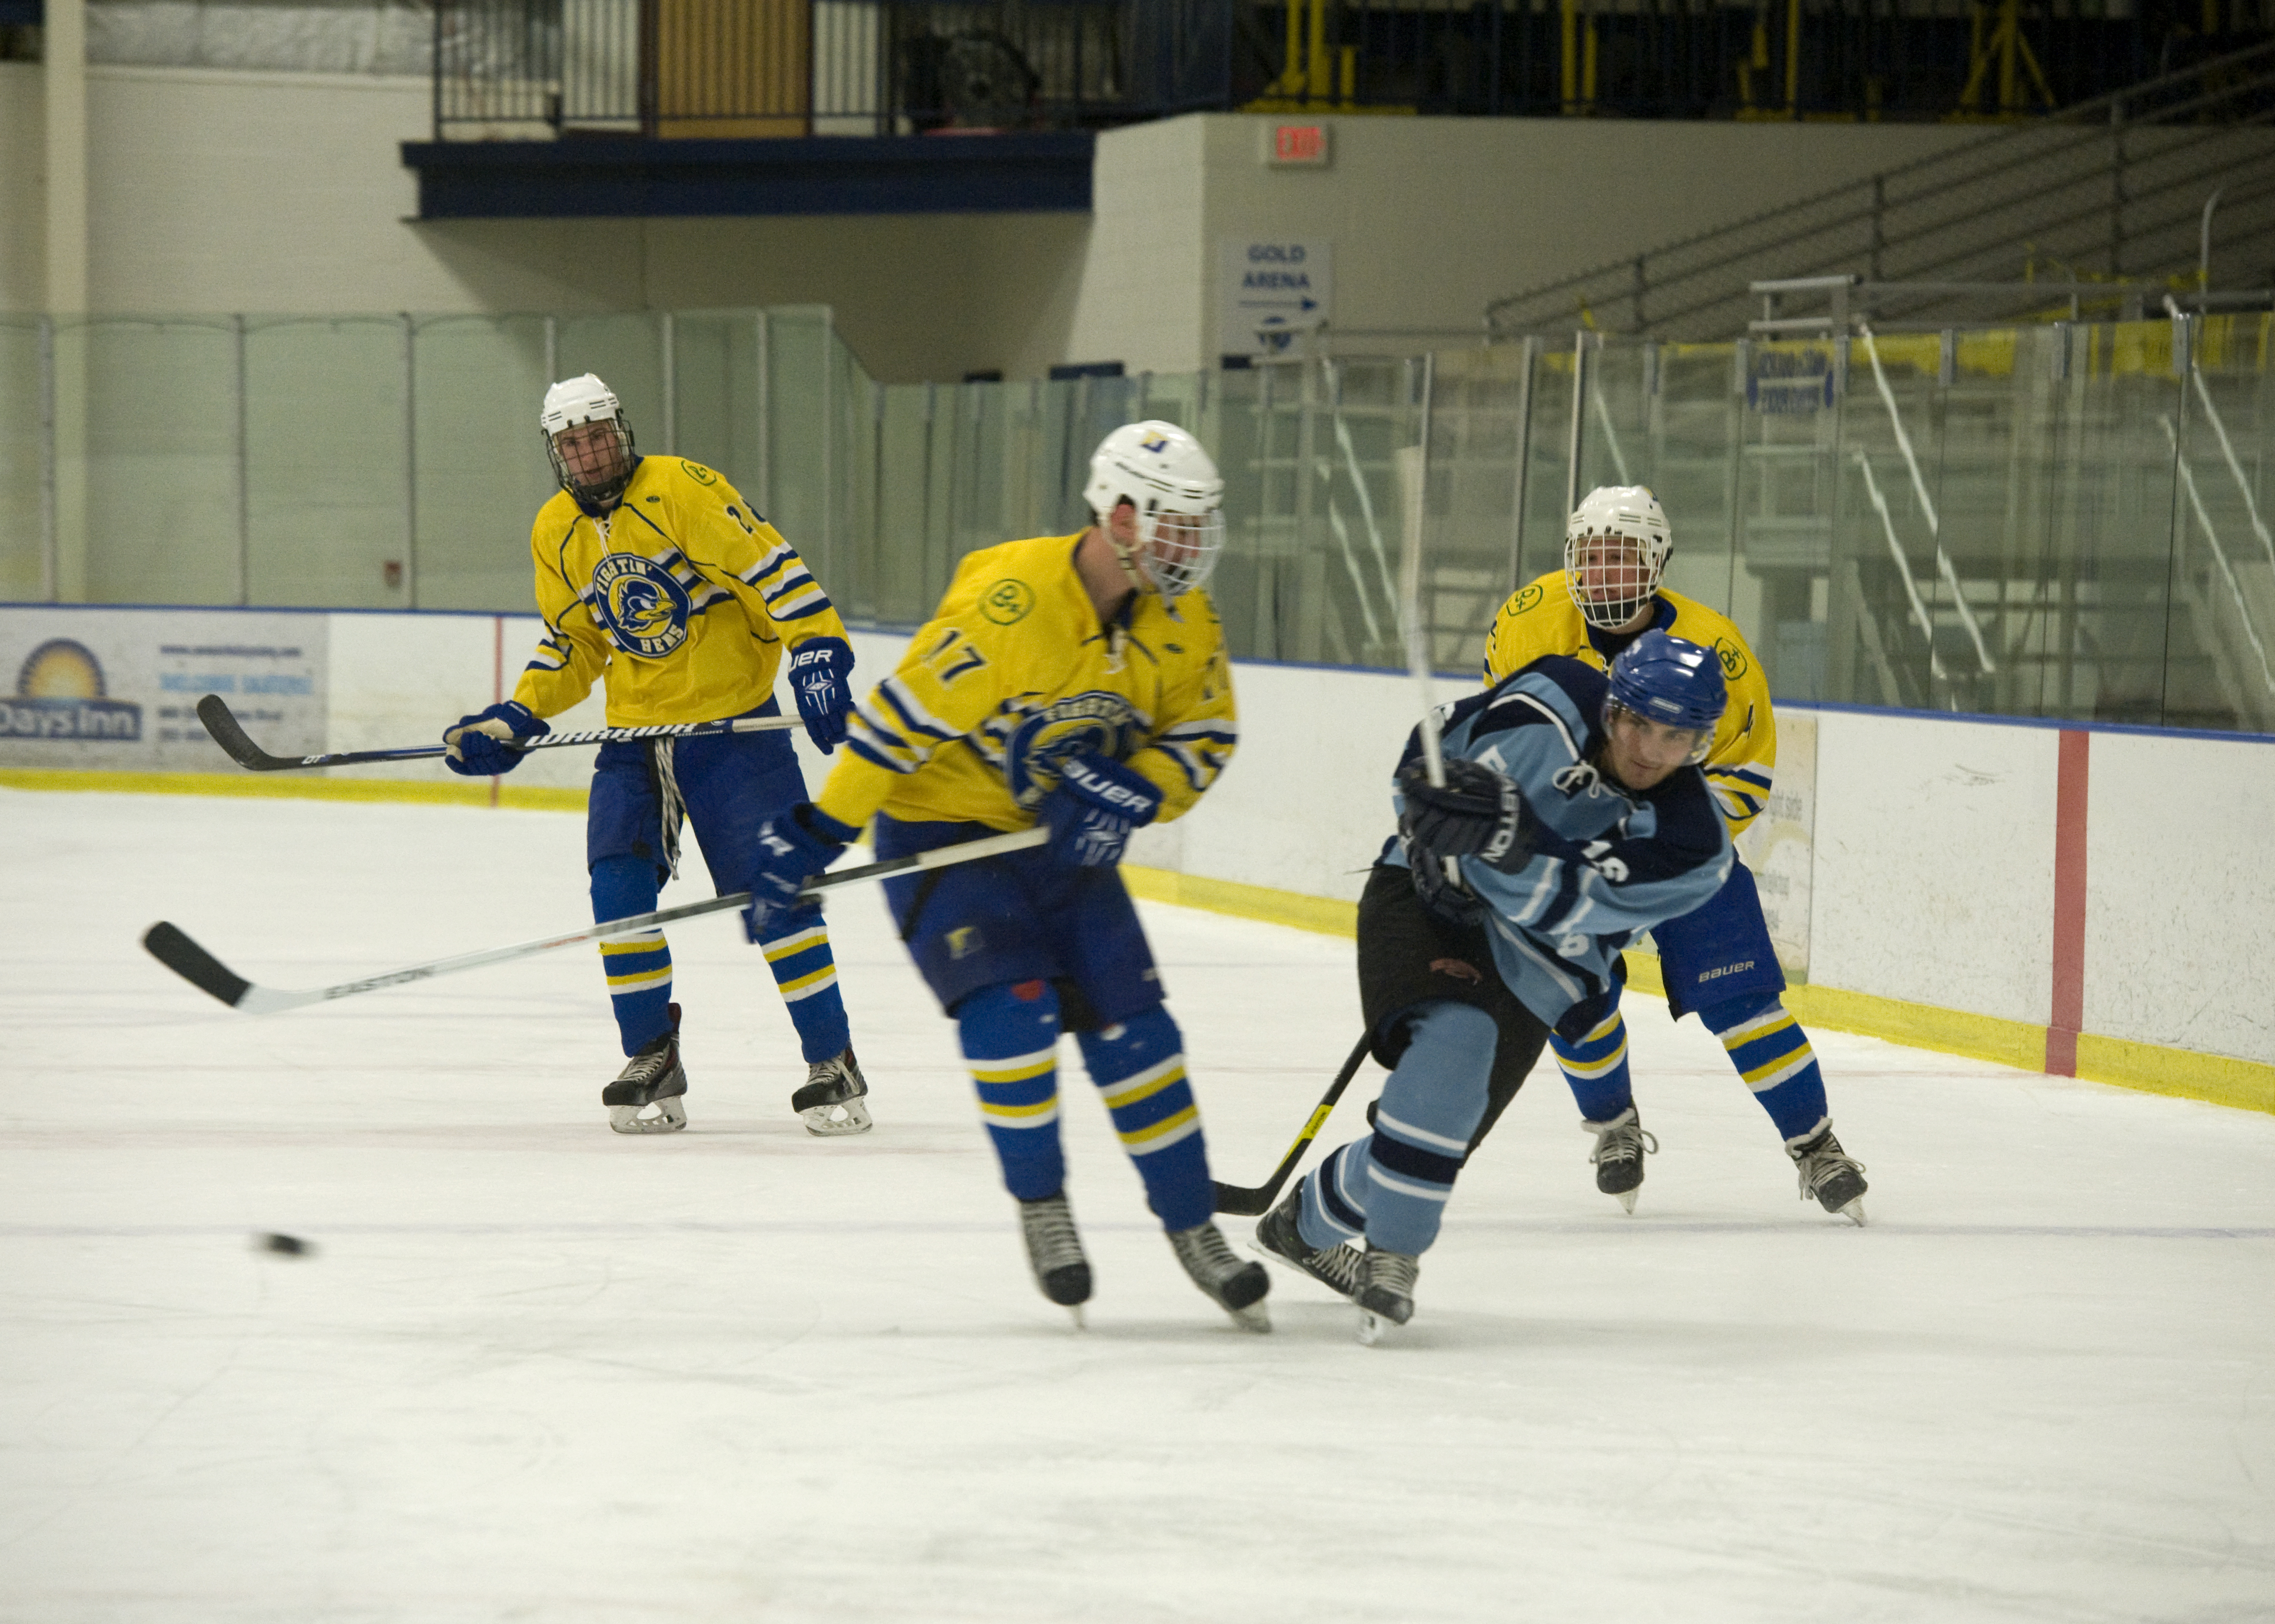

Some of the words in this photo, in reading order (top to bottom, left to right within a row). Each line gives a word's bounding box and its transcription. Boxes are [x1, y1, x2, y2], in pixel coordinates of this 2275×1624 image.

[1247, 244, 1306, 265] GOLD
[1243, 271, 1311, 290] ARENA
[639, 624, 684, 653] HENS
[919, 629, 987, 684] 17
[525, 723, 698, 746] WARRIOR
[1699, 961, 1755, 983] BAUER
